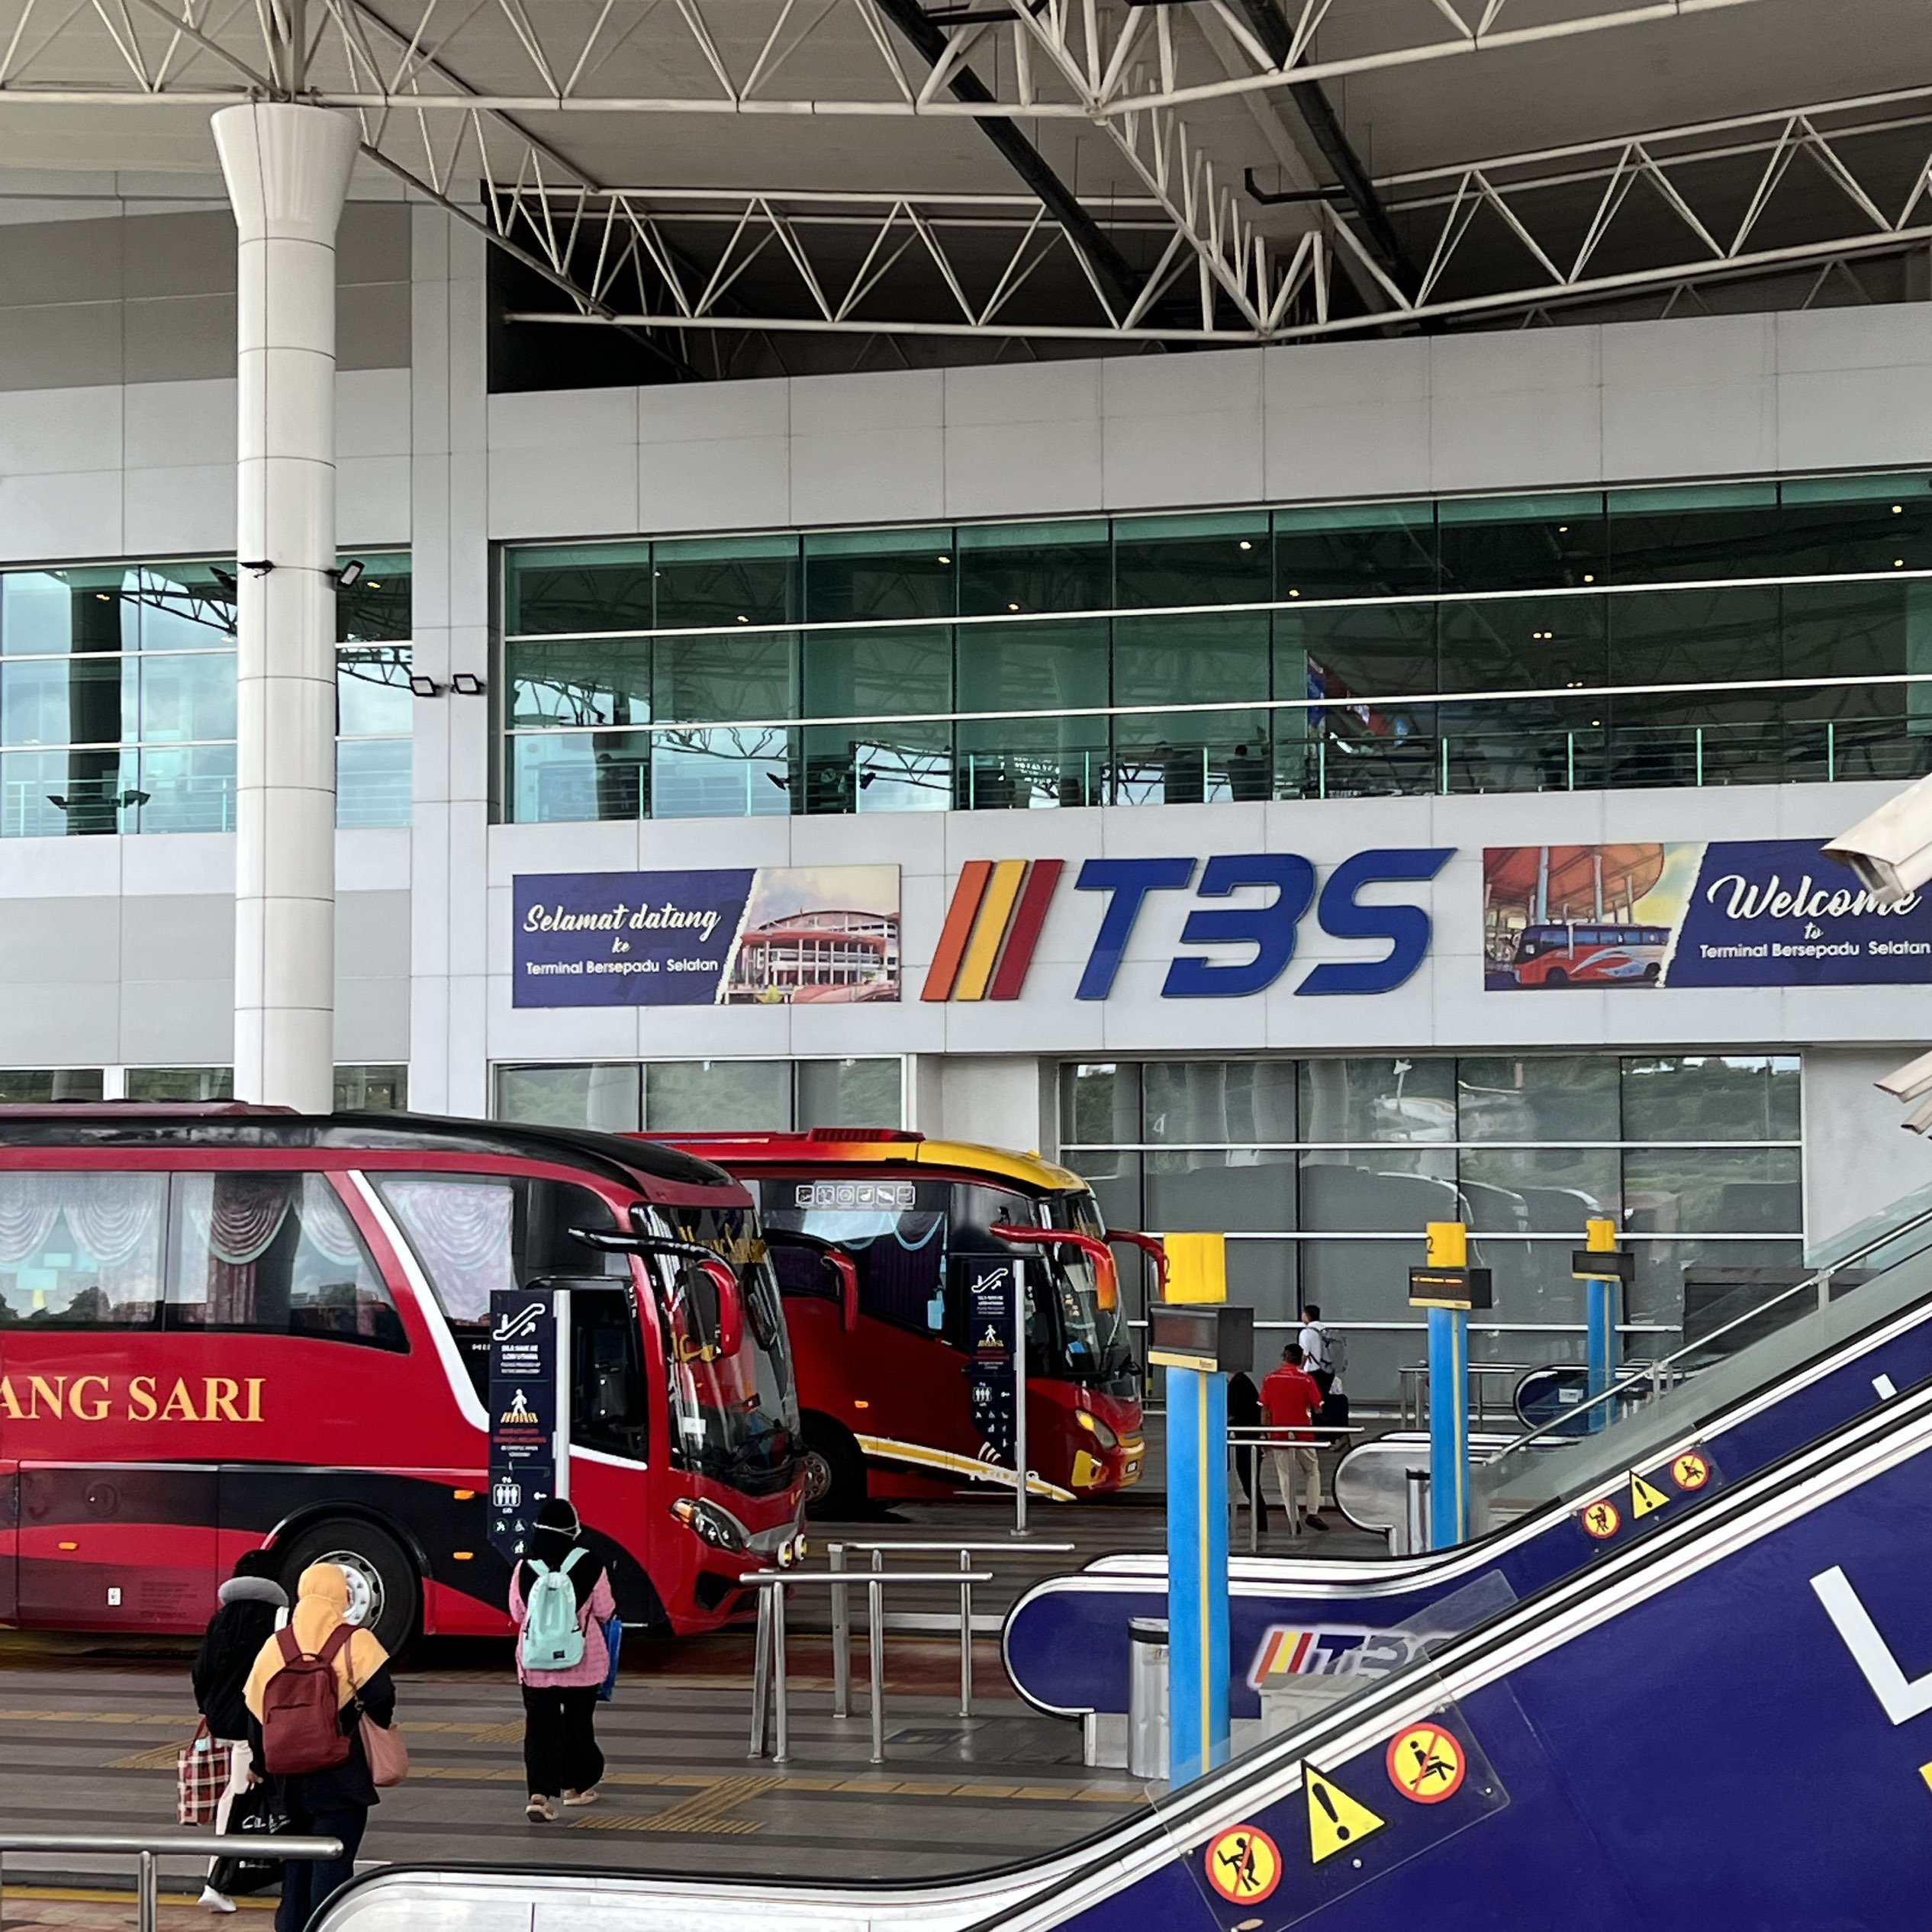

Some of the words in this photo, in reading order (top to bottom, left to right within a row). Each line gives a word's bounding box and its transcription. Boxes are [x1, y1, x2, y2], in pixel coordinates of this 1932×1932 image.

[1707, 874, 1922, 919] Welcome
[523, 903, 627, 932] Selamat
[629, 903, 722, 942] datang
[1074, 848, 1457, 1000] TBS
[1804, 921, 1824, 940] to
[611, 935, 630, 954] ke
[1699, 943, 1768, 959] Terminal
[1772, 942, 1860, 958] Bersepadu
[1868, 940, 1931, 955] Selatan
[526, 961, 583, 975] Terminal
[586, 959, 660, 976] Bersepadu
[666, 958, 719, 972] Selatan
[127, 1376, 266, 1422] SARI
